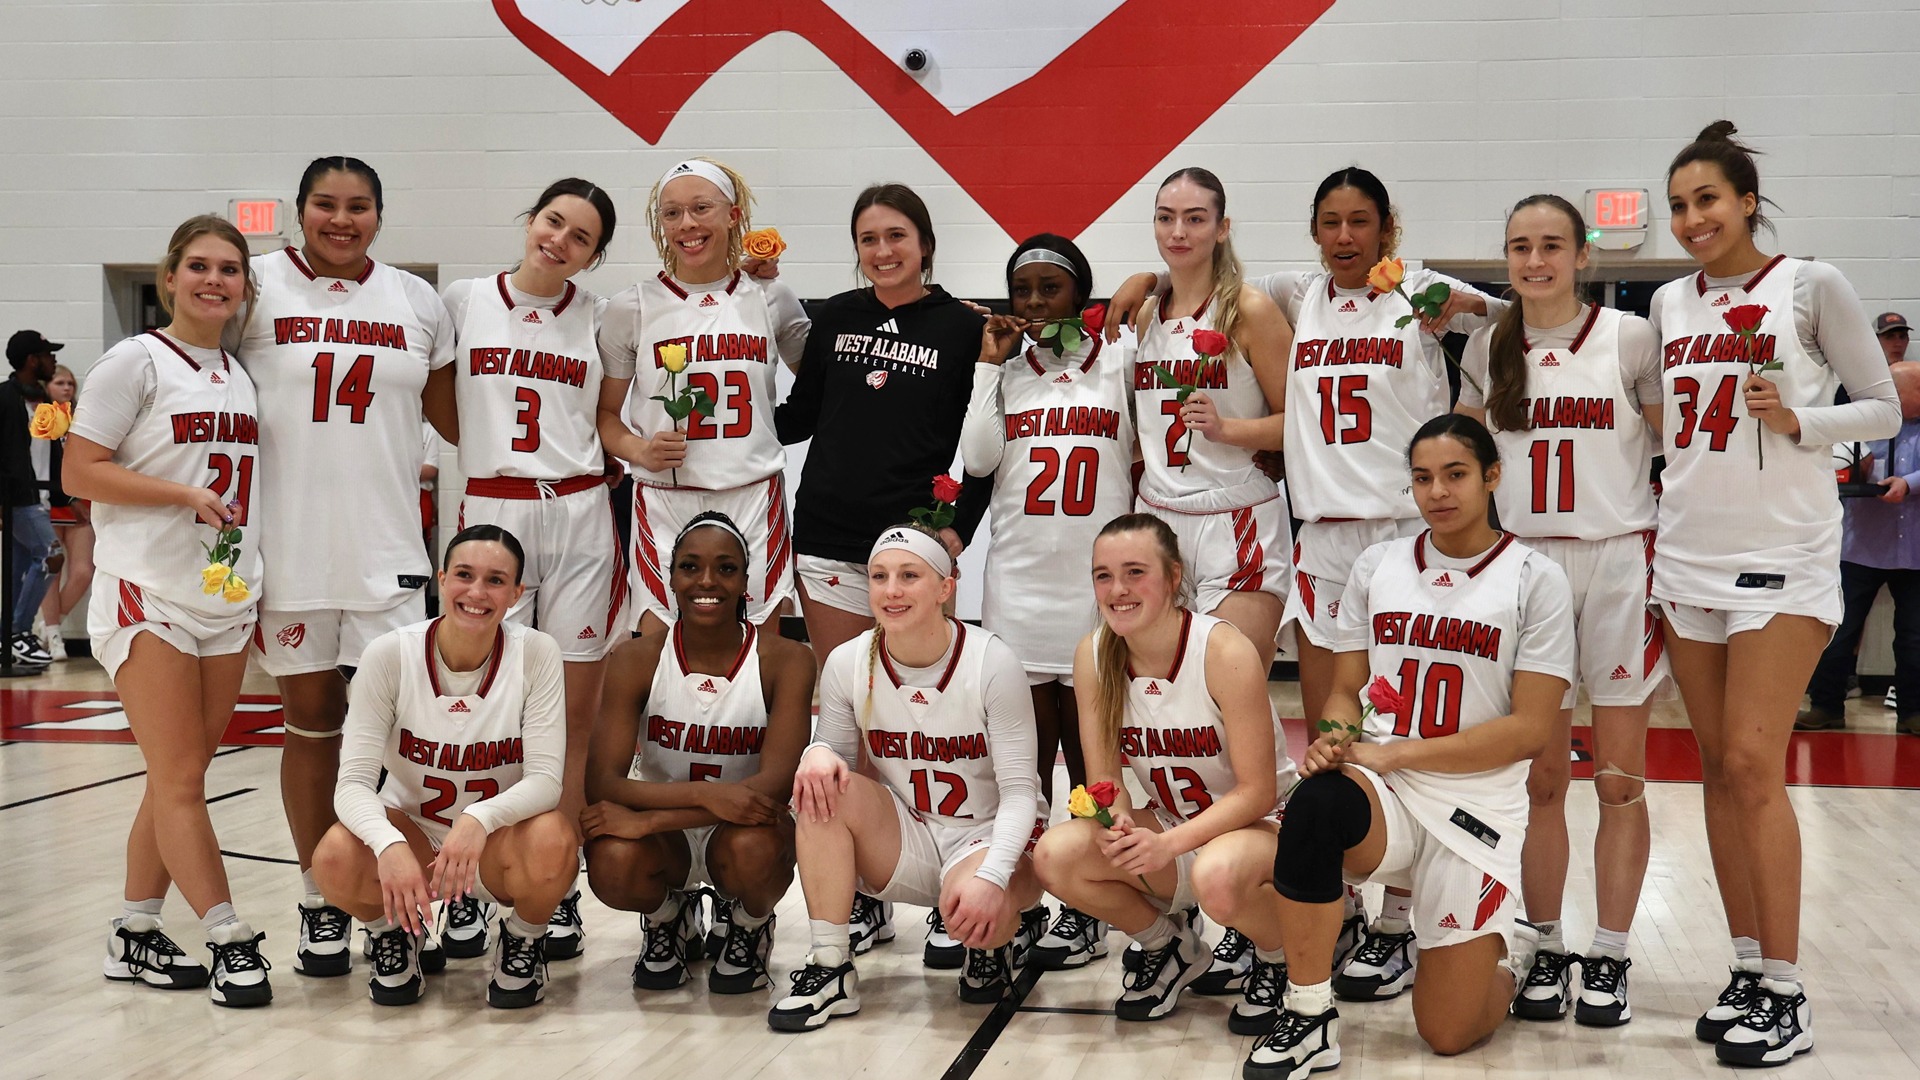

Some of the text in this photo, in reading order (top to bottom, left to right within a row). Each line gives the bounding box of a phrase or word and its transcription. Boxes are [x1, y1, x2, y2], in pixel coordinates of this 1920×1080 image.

[237, 202, 277, 233] EXIT
[1596, 192, 1642, 227] EXIT
[274, 316, 408, 351] WEST ALABAMA
[696, 333, 768, 365] ALABAMA
[834, 333, 939, 370] WEST ALABAMA
[1324, 337, 1403, 369] ALABAMA
[1663, 333, 1776, 373] EST ALABAMA
[470, 347, 588, 389] WEST ALABAMA
[837, 354, 925, 377] BASKETBALL
[311, 352, 375, 424] 14
[686, 370, 753, 441] 23
[171, 412, 259, 445] WEST ALABA
[511, 386, 541, 453] 3
[1005, 406, 1120, 442] WEST ALABAMA
[1317, 374, 1372, 445] 15
[1531, 396, 1614, 430] ALABAMA
[1673, 375, 1739, 452] 34
[1161, 399, 1192, 467] 2
[195, 453, 254, 526] 21
[1024, 446, 1099, 516] 20
[1528, 439, 1575, 513] 11
[1373, 611, 1502, 662] WEST ALABAMA
[1391, 658, 1464, 739] 10
[399, 728, 524, 772] WEST ALABAMA
[647, 715, 686, 750] WEST
[867, 729, 908, 760] WEST
[1119, 725, 1222, 758] EST ALABAMA
[909, 769, 974, 819] 12
[1150, 766, 1214, 820] 13
